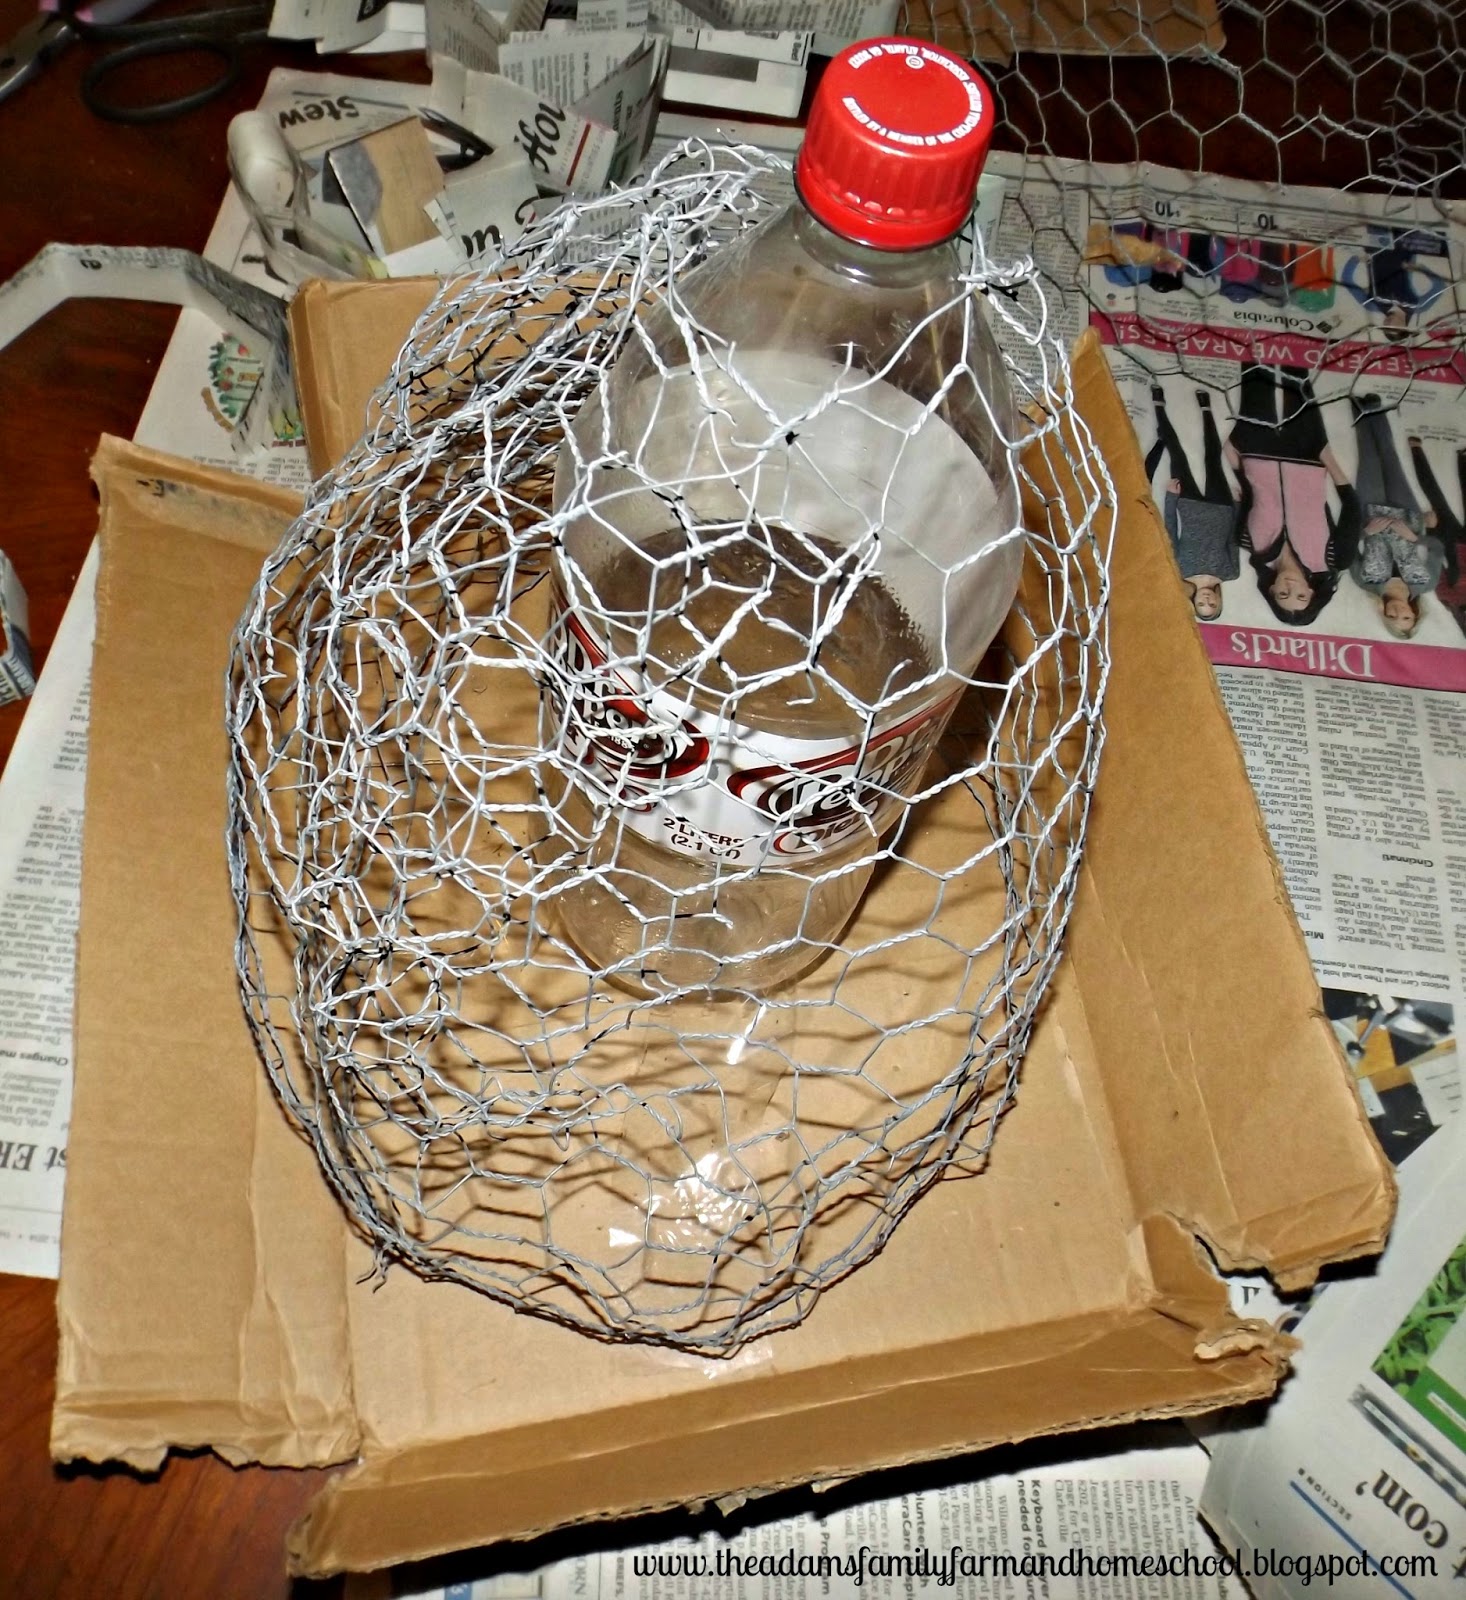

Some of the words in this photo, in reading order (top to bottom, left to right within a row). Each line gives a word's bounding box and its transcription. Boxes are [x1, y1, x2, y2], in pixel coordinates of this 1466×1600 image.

[279, 95, 360, 128] Stew
[1232, 310, 1313, 332] Columbia
[1231, 632, 1375, 678] Dillard's
[663, 817, 676, 830] 2
[1381, 853, 1433, 867] Cincinnati
[20, 1049, 68, 1066] Changes
[1015, 1480, 1031, 1531] needed
[1028, 1479, 1048, 1548] Keyboard
